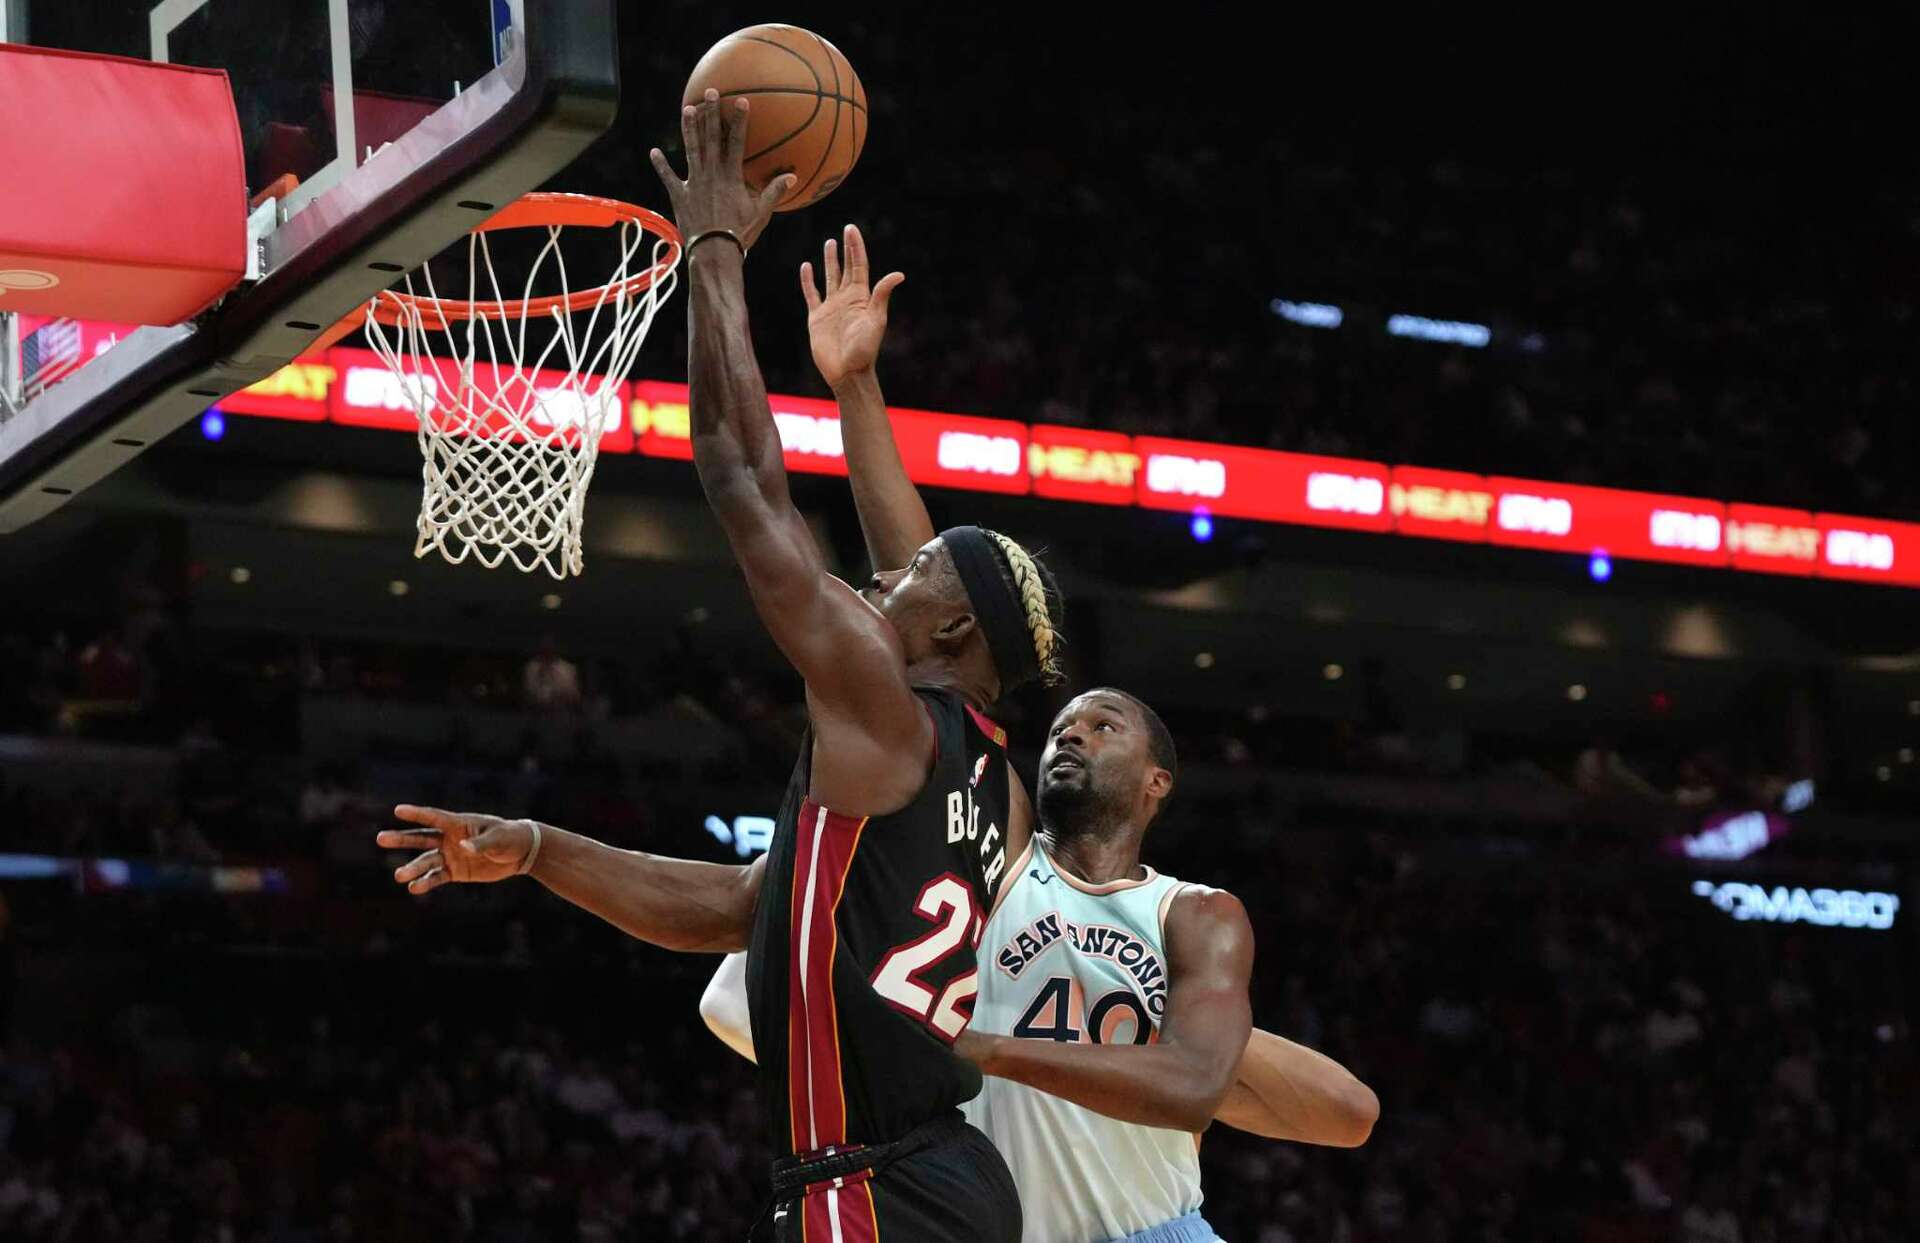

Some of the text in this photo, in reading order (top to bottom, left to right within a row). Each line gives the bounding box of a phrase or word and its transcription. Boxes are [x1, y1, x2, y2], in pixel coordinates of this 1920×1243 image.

[1028, 443, 1142, 486] HEAT
[868, 871, 987, 1046] 22
[997, 912, 1167, 1016] SAN ANTONIO
[1012, 975, 1152, 1045] 40
